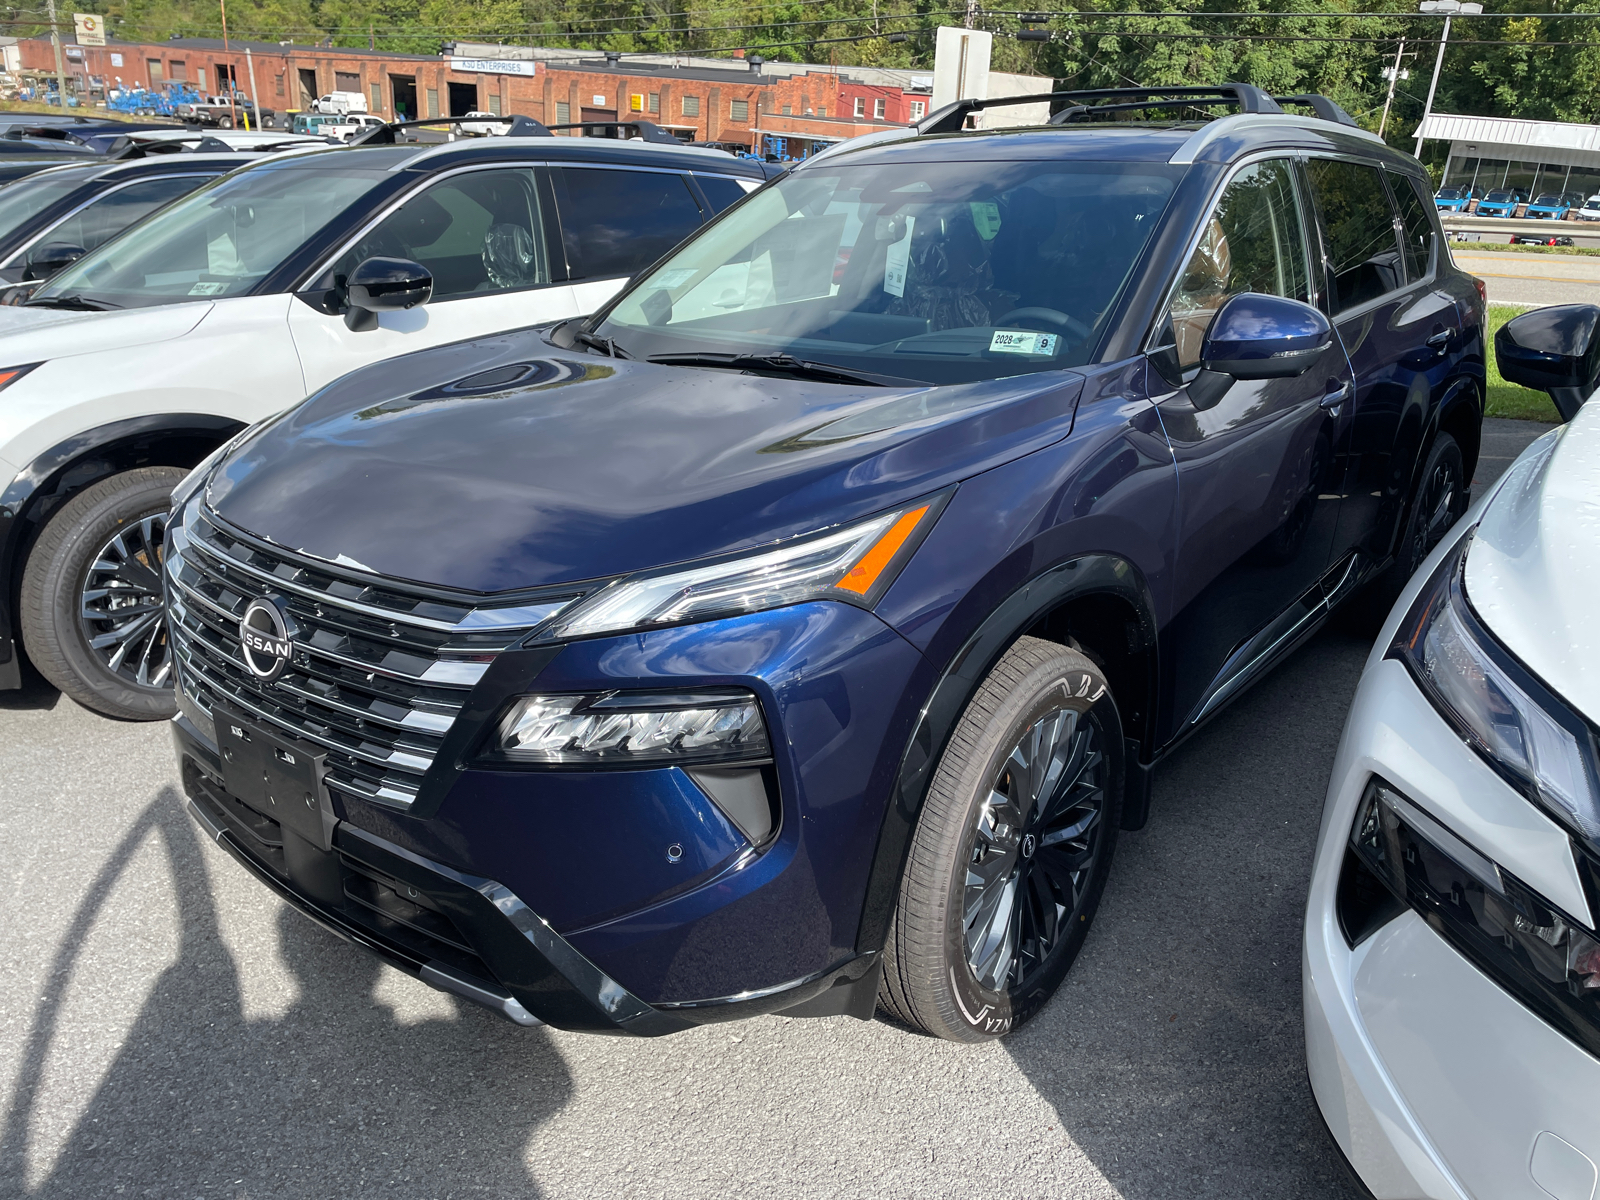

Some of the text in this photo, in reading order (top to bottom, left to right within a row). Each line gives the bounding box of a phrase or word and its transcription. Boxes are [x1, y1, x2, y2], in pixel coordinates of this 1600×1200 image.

[476, 60, 521, 72] ENTERPRISES
[995, 335, 1013, 344] 2028
[1041, 339, 1048, 348] 9
